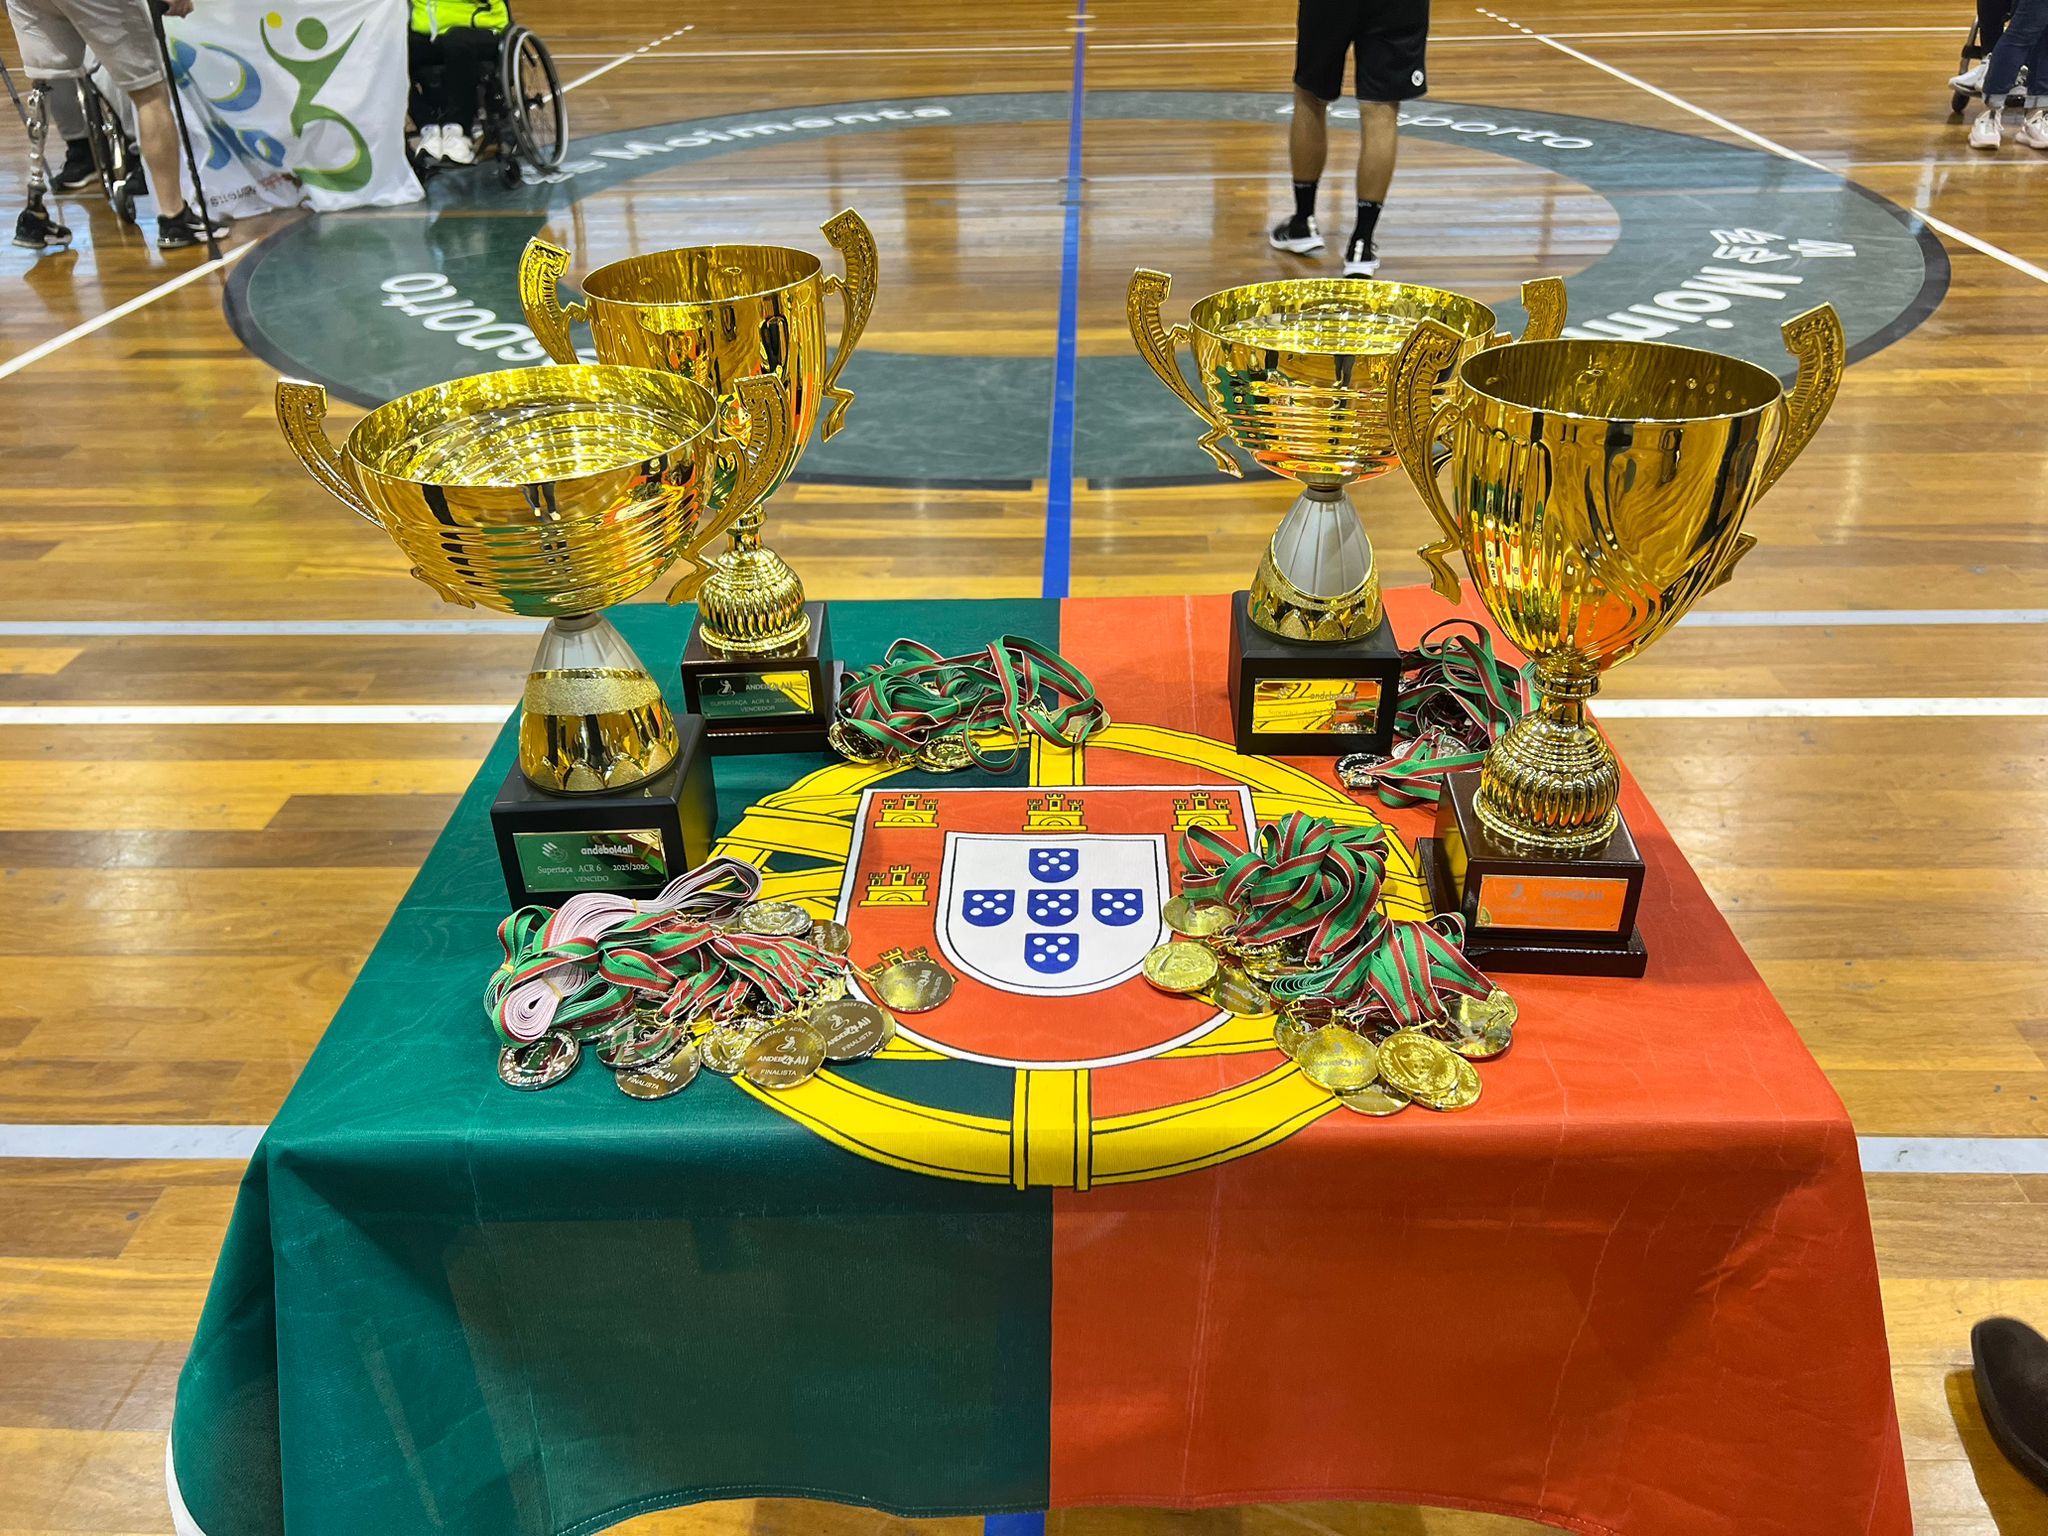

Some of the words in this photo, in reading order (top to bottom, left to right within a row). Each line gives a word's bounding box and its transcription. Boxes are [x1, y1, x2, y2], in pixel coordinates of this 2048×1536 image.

[581, 844, 633, 855] andebol4all
[537, 865, 573, 875] Supertaça
[578, 863, 595, 873] ACR
[612, 862, 650, 872] 2025/2026
[574, 875, 609, 883] VENCIDO
[760, 1068, 797, 1077] FINALISTA
[626, 1076, 660, 1090] FINALISTA
